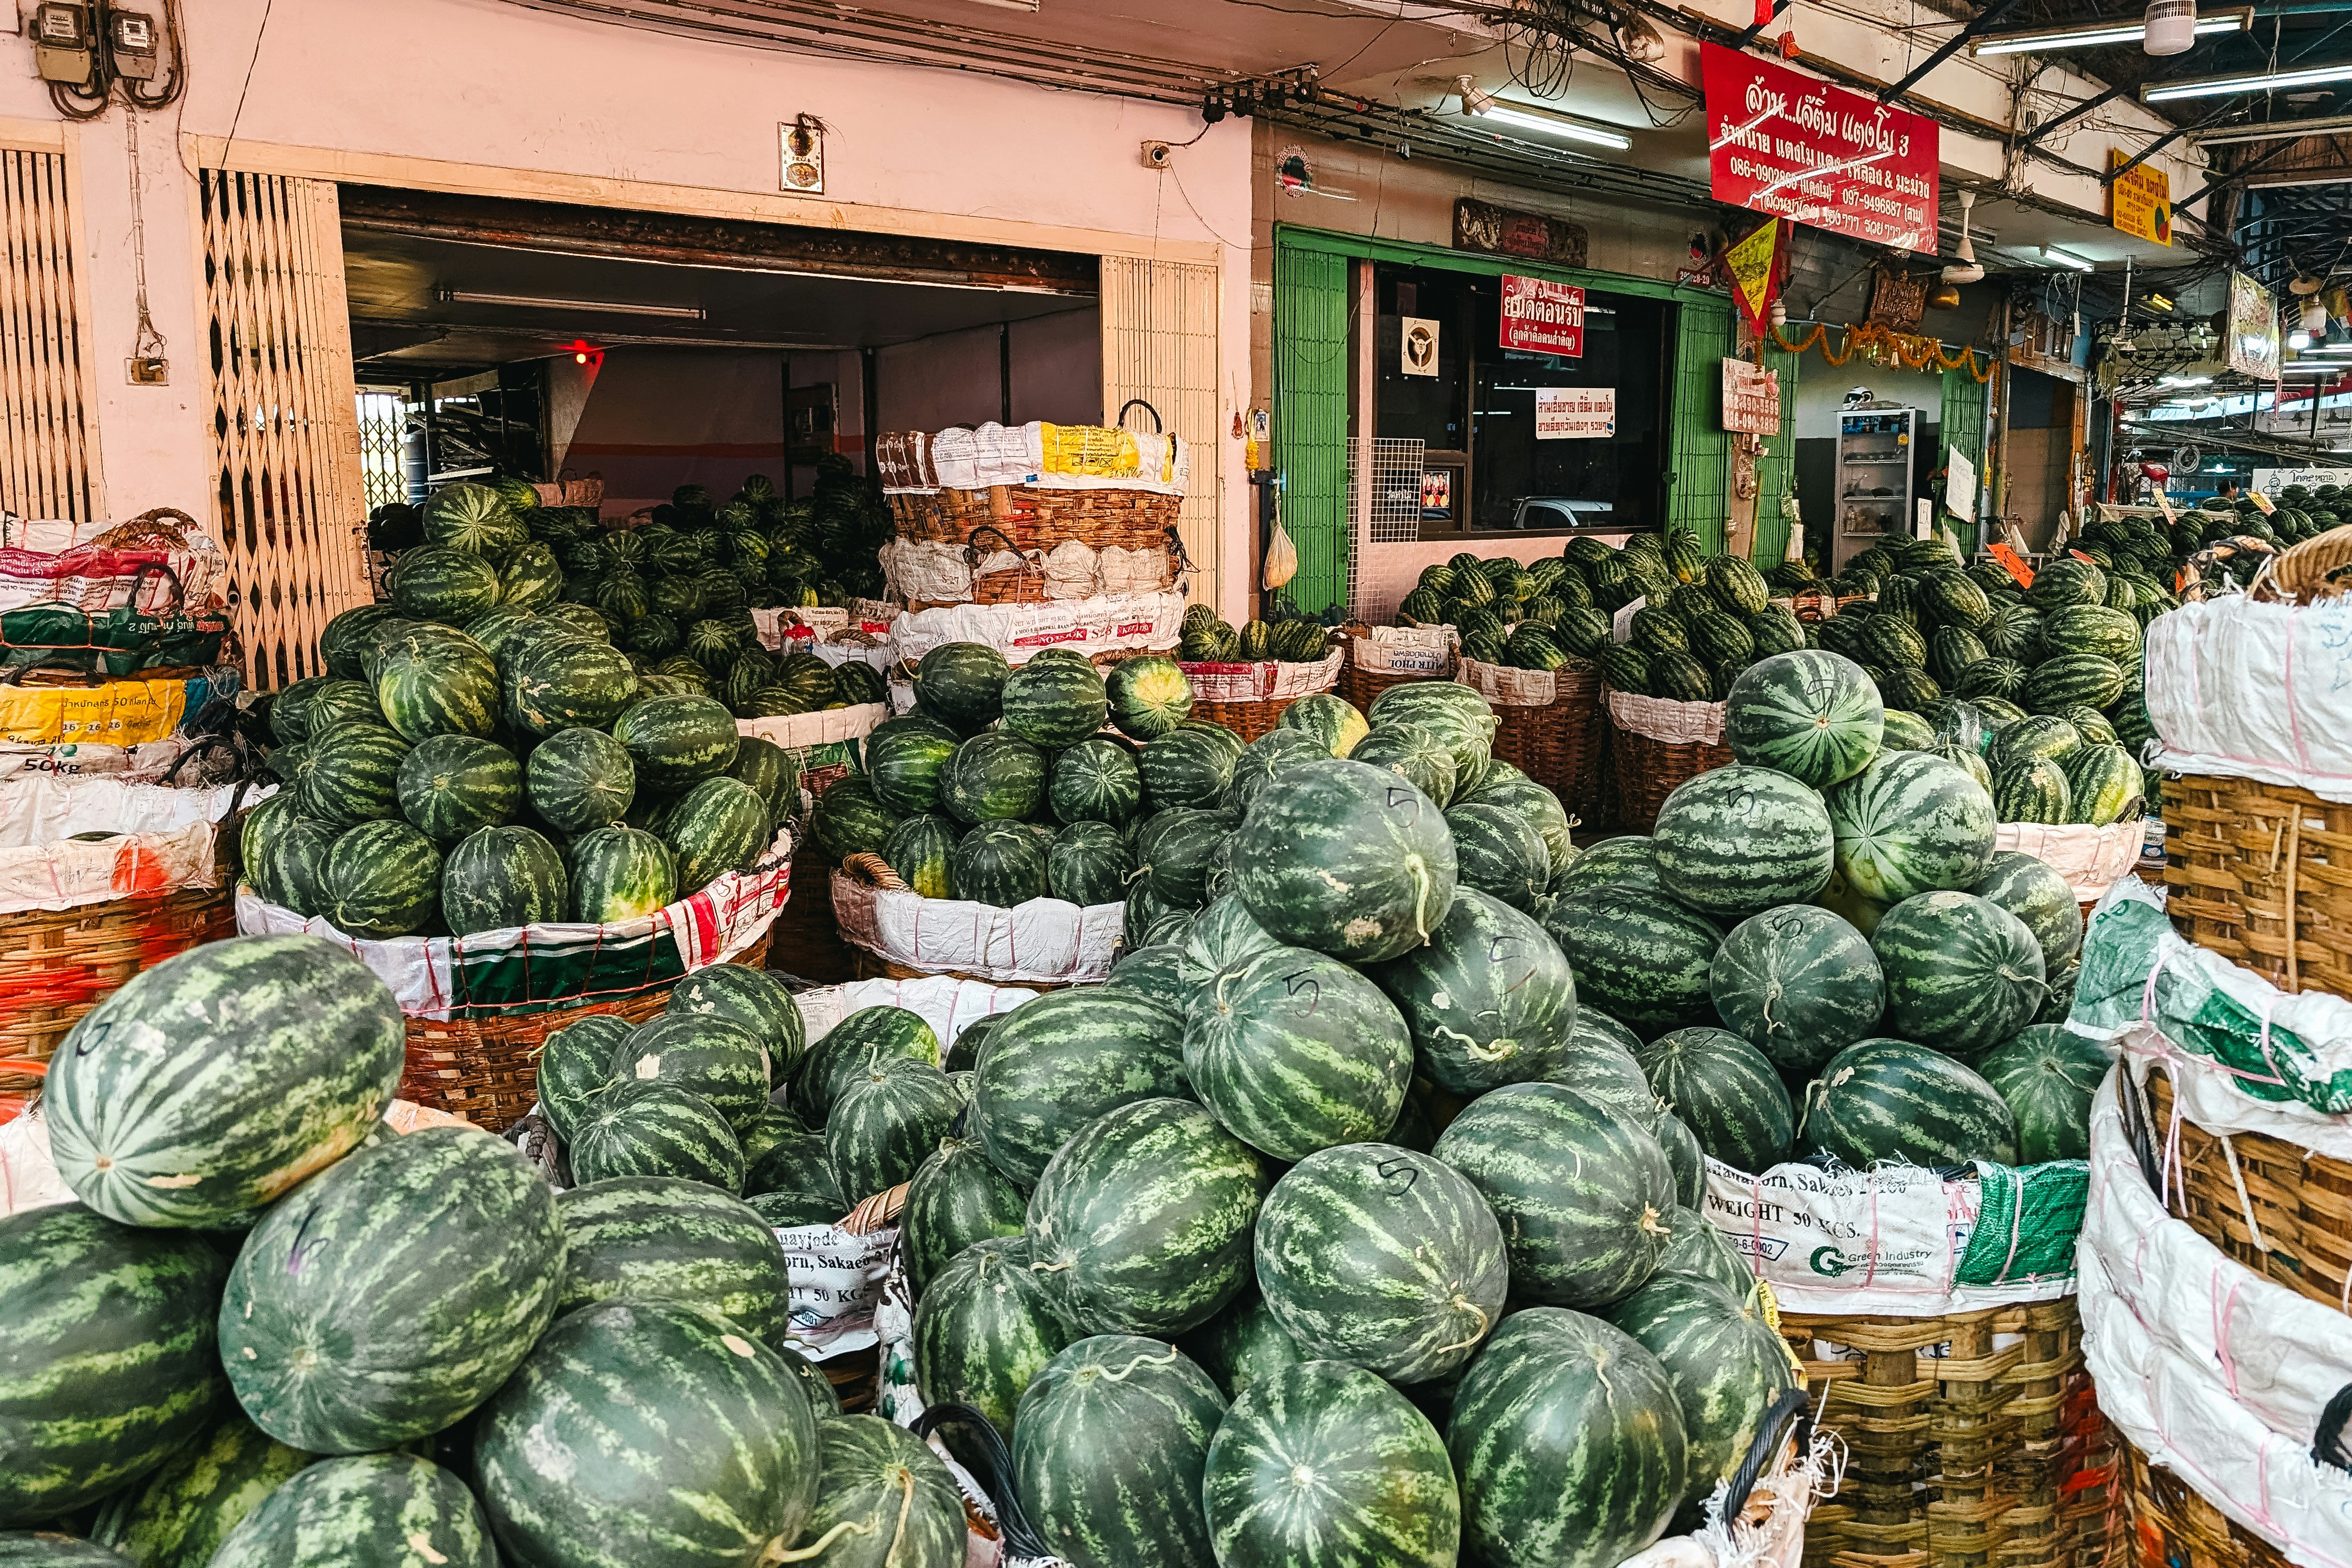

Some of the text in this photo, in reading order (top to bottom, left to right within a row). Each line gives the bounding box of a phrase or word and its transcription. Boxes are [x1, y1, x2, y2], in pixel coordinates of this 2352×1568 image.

[1842, 106, 1894, 152] แตงโม
[1899, 135, 1909, 157] 3
[1776, 138, 1814, 167] แตงโม
[1884, 170, 1893, 189] &
[1896, 173, 1930, 200] มะม่วง
[1843, 188, 1902, 218] 097-9496887
[1509, 324, 1575, 351] (ลูกค้าคือคนสำคัญ)
[1388, 659, 1444, 670] MITR PHOL
[114, 697, 127, 706] 50
[24, 758, 82, 775] 50kg
[1386, 786, 1420, 828] 5
[1726, 784, 1755, 815] 5
[1772, 910, 1804, 939] 5
[1282, 968, 1319, 1019] 5
[1376, 1156, 1418, 1197] 5
[1707, 1194, 1783, 1222] WEIGHT
[1794, 1212, 1811, 1227] 50
[1848, 1250, 1932, 1263] Green Industry
[814, 1289, 829, 1302] 50
